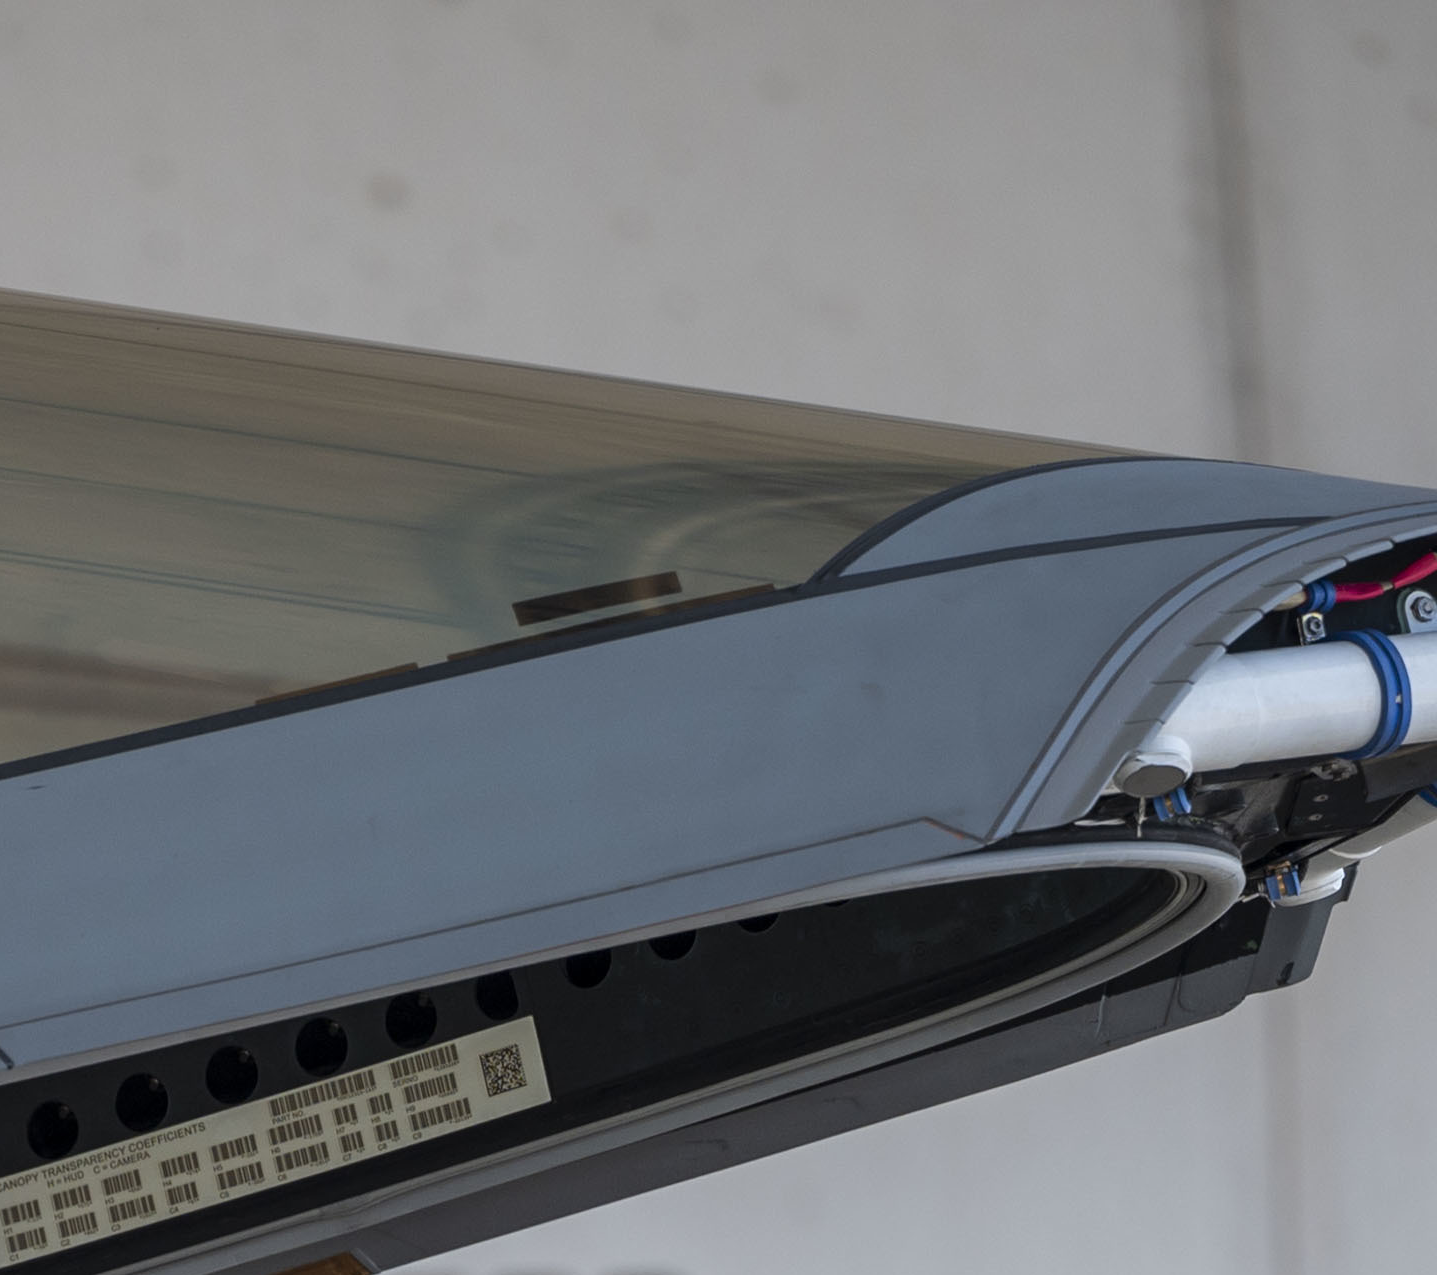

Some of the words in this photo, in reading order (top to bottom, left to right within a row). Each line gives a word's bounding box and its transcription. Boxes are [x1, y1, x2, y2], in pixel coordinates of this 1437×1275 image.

[272, 1114, 291, 1126] PART
[41, 1146, 126, 1180] TRANSPARENCY
[127, 1122, 206, 1153] COEFFICIENTS
[63, 1171, 85, 1184] HUD
[109, 1151, 152, 1170] CAMERA
